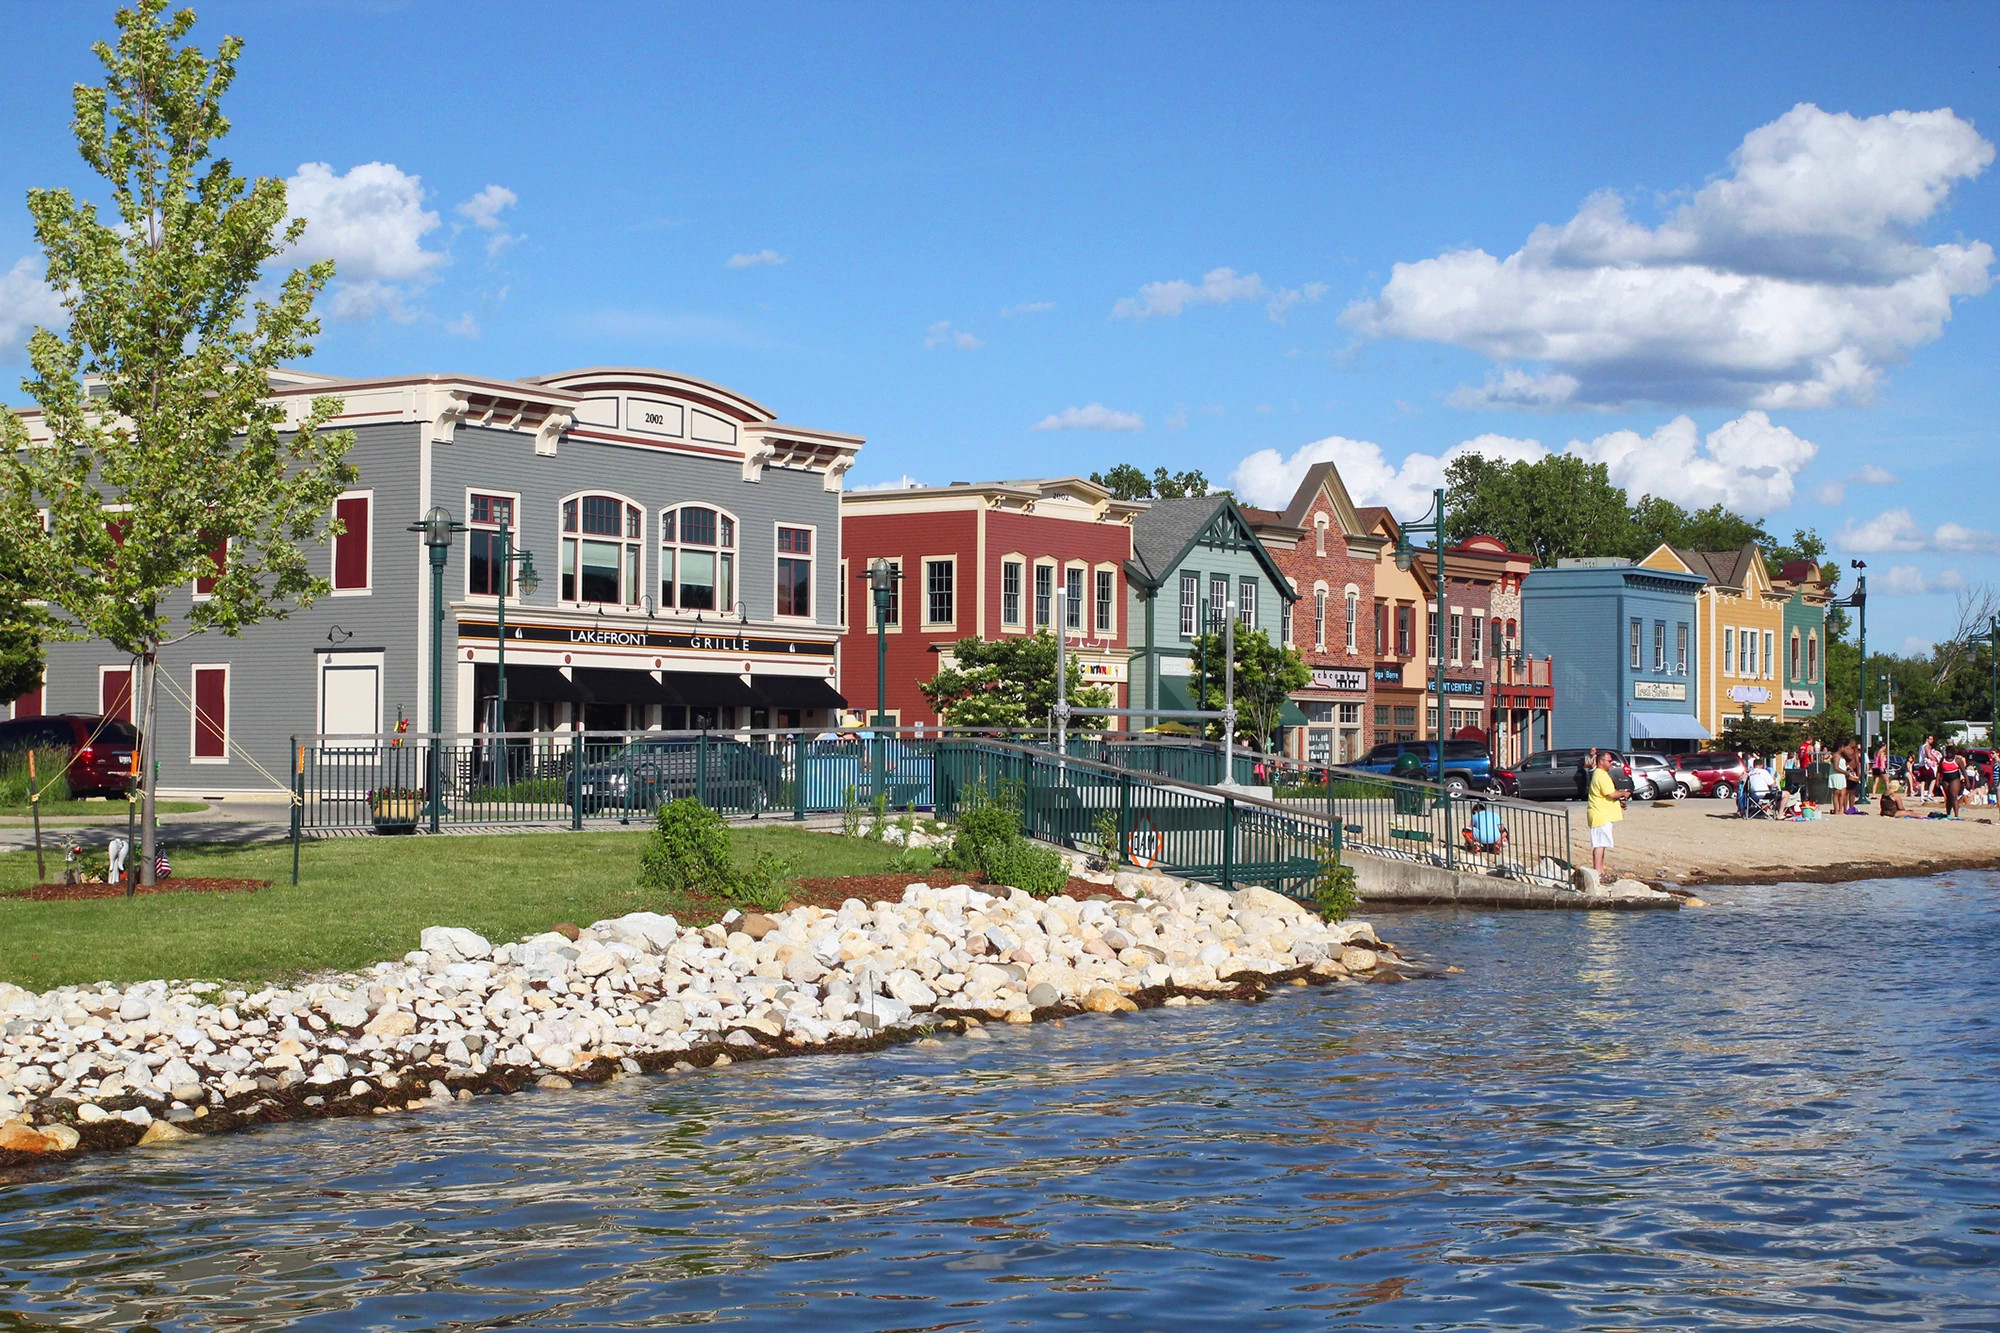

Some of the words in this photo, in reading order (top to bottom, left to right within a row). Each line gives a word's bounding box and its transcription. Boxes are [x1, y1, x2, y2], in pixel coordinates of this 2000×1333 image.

[645, 413, 664, 425] 2002
[570, 630, 648, 646] LAKEFRONT
[690, 637, 750, 651] GRILLE
[1080, 664, 1112, 675] CANTINA
[1312, 670, 1360, 680] chcomber
[1374, 671, 1384, 679] oga
[1386, 671, 1399, 679] Barre
[1450, 682, 1472, 692] CENTER
